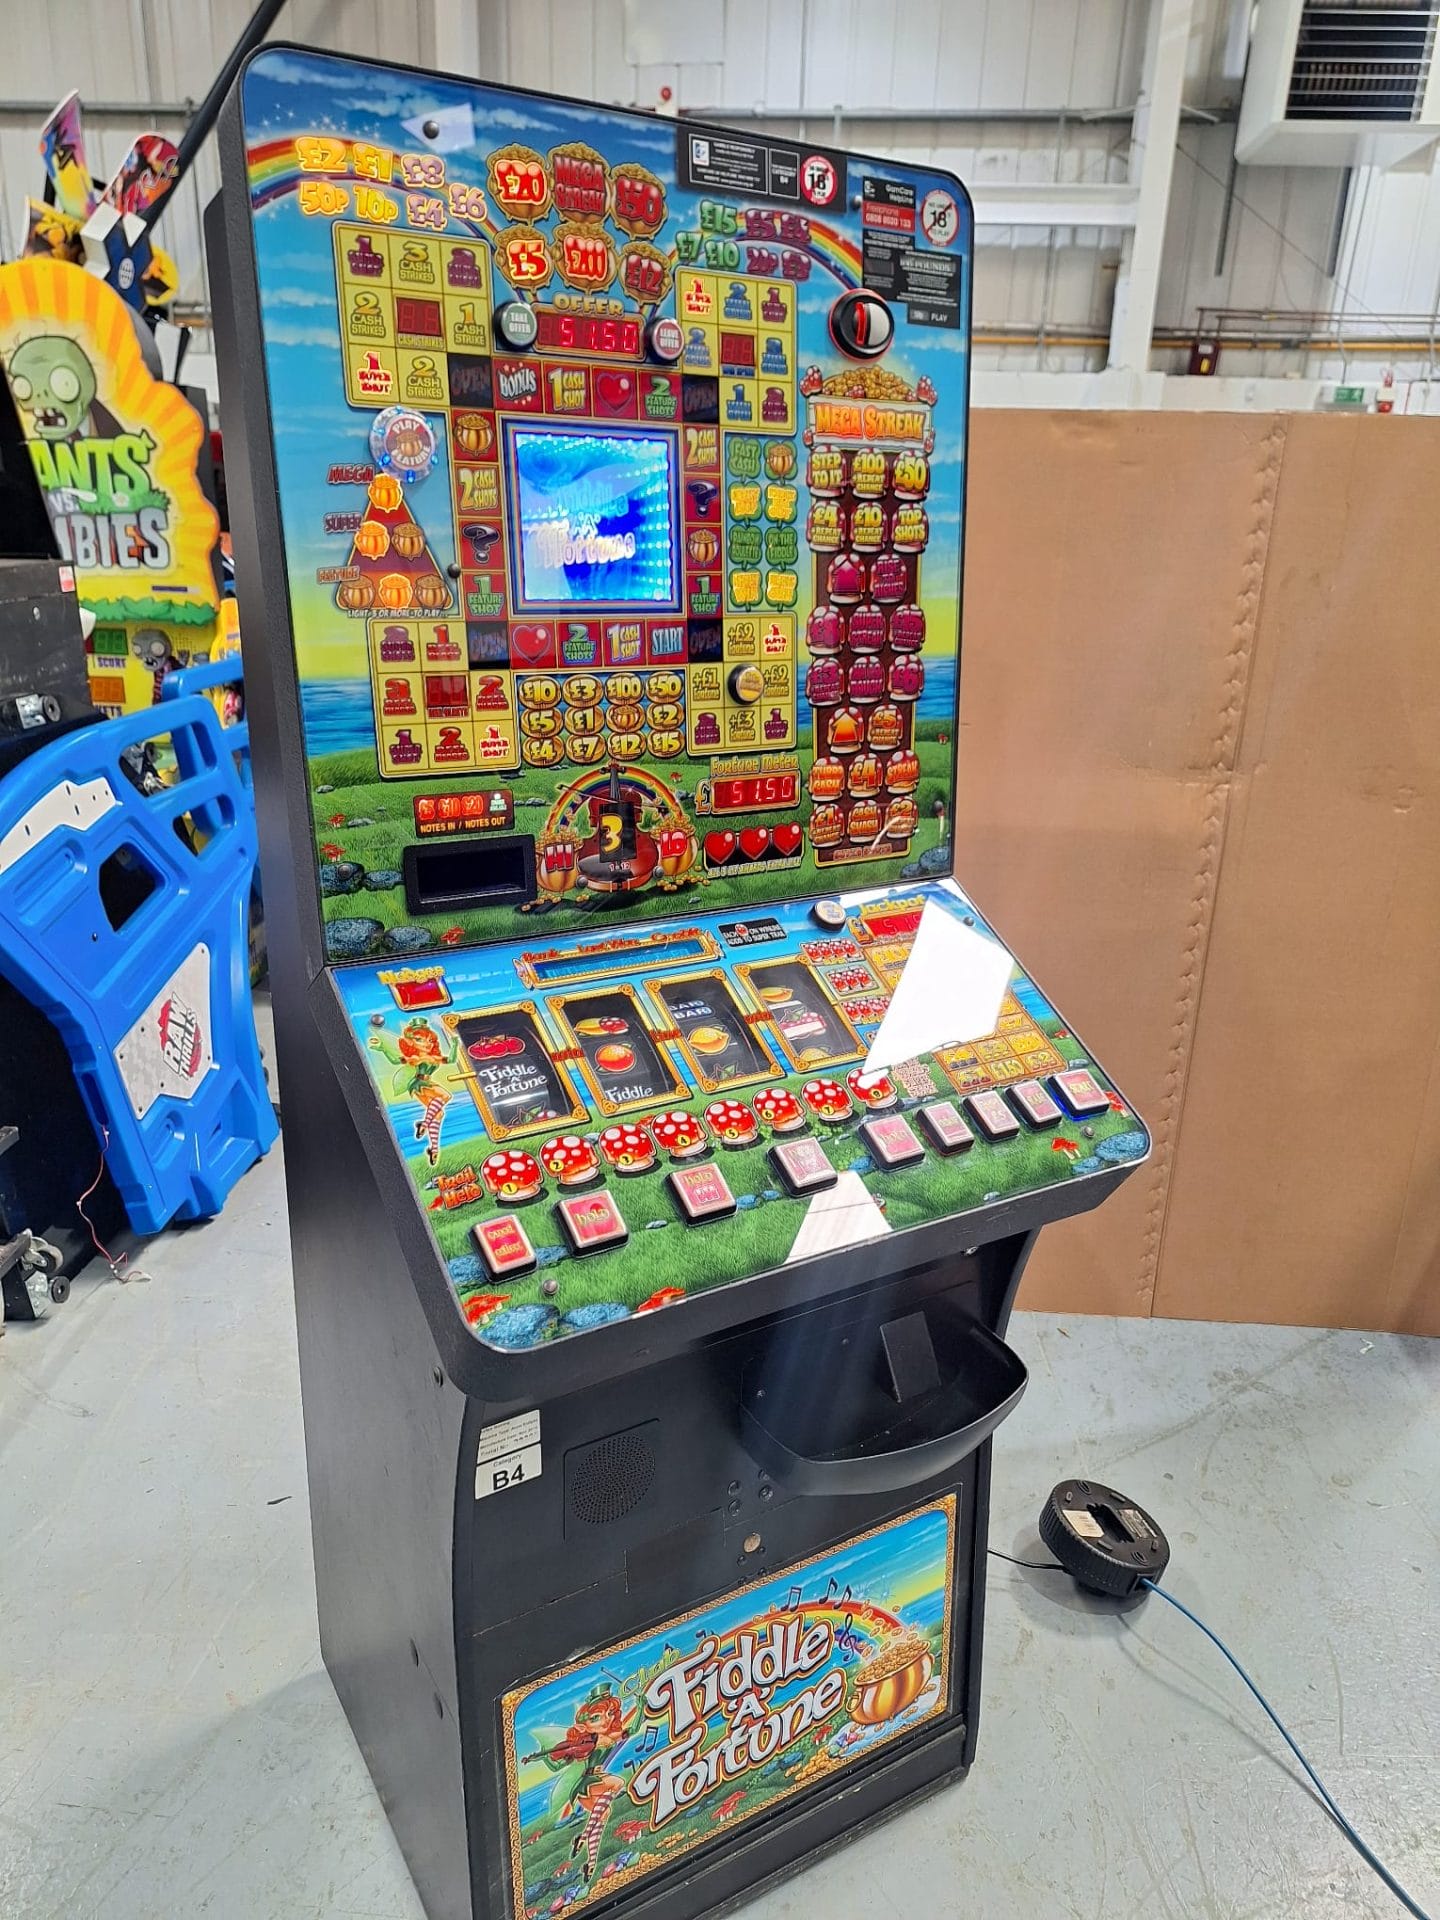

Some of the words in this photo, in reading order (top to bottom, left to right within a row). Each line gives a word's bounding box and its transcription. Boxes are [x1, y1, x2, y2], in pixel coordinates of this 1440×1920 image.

[295, 137, 347, 172] £2
[353, 143, 393, 183] £1
[401, 154, 445, 188] £8
[300, 181, 348, 215] 50p
[354, 184, 398, 223] 10p
[407, 194, 447, 230] £4
[450, 184, 486, 222] £6
[700, 200, 738, 234] £15
[404, 241, 430, 262] 3
[507, 240, 548, 280] £5
[676, 231, 702, 262] £7
[705, 240, 739, 270] £10
[399, 270, 434, 284] STRIKES
[400, 261, 432, 273] CASH
[354, 291, 380, 315] 2
[554, 293, 624, 316] OFFER
[352, 315, 384, 327] CASH
[459, 303, 476, 325] 1
[351, 325, 386, 337] STRIKES
[454, 324, 486, 336] CASH
[454, 332, 486, 346] STRIKE
[412, 356, 436, 376] 2
[406, 386, 443, 399] STRIKES
[408, 376, 441, 389] CASH
[499, 368, 537, 400] BONUS
[563, 388, 586, 411] SHOT
[392, 419, 421, 434] PLAY
[814, 403, 863, 438] MEGA
[863, 405, 926, 441] STREAK
[812, 453, 842, 471] STEP
[852, 455, 886, 474] £100
[328, 464, 375, 484] MEGA
[813, 471, 828, 488] TO
[828, 470, 842, 487] IT
[895, 455, 927, 491] £50
[813, 506, 838, 527] £4
[854, 506, 883, 527] £10
[898, 508, 922, 527] TOP
[894, 525, 926, 543] SHOTS
[379, 609, 389, 618] OR
[470, 603, 501, 616] SHOT
[568, 624, 588, 643] 2
[652, 627, 684, 656] START
[728, 623, 755, 642] +£2
[620, 640, 641, 658] SHOT
[693, 667, 720, 690] +£1
[764, 664, 789, 686] +£2
[522, 679, 557, 703] £10
[569, 677, 597, 700] £3
[606, 675, 642, 699] £100
[649, 673, 683, 699] £50
[528, 709, 556, 734] £5
[573, 708, 596, 732] £1
[652, 704, 679, 727] £2
[729, 709, 755, 730] +£3
[529, 739, 556, 762] £4
[572, 736, 599, 759] £7
[611, 734, 642, 757] £12
[651, 732, 680, 755] £15
[851, 758, 877, 788] £4
[695, 779, 711, 816] £
[813, 779, 842, 795] CASH
[853, 806, 878, 820] CASH
[421, 823, 446, 833] NOTES
[447, 821, 455, 830] IN
[465, 818, 490, 829] NOTES
[491, 816, 506, 825] OUT
[601, 815, 623, 853] 3
[850, 819, 879, 836] SMASH
[660, 829, 688, 858] LO
[546, 843, 573, 872] HI
[674, 1006, 713, 1020] BAR
[163, 991, 188, 1075] RAW
[479, 1063, 538, 1083] Fiddle
[485, 1075, 548, 1100] Fortune
[606, 1085, 654, 1103] Fiddle
[493, 1454, 522, 1468] Category
[493, 1464, 525, 1491] B4
[645, 1613, 835, 1738] Fiddle
[630, 1669, 848, 1828] Fortune
